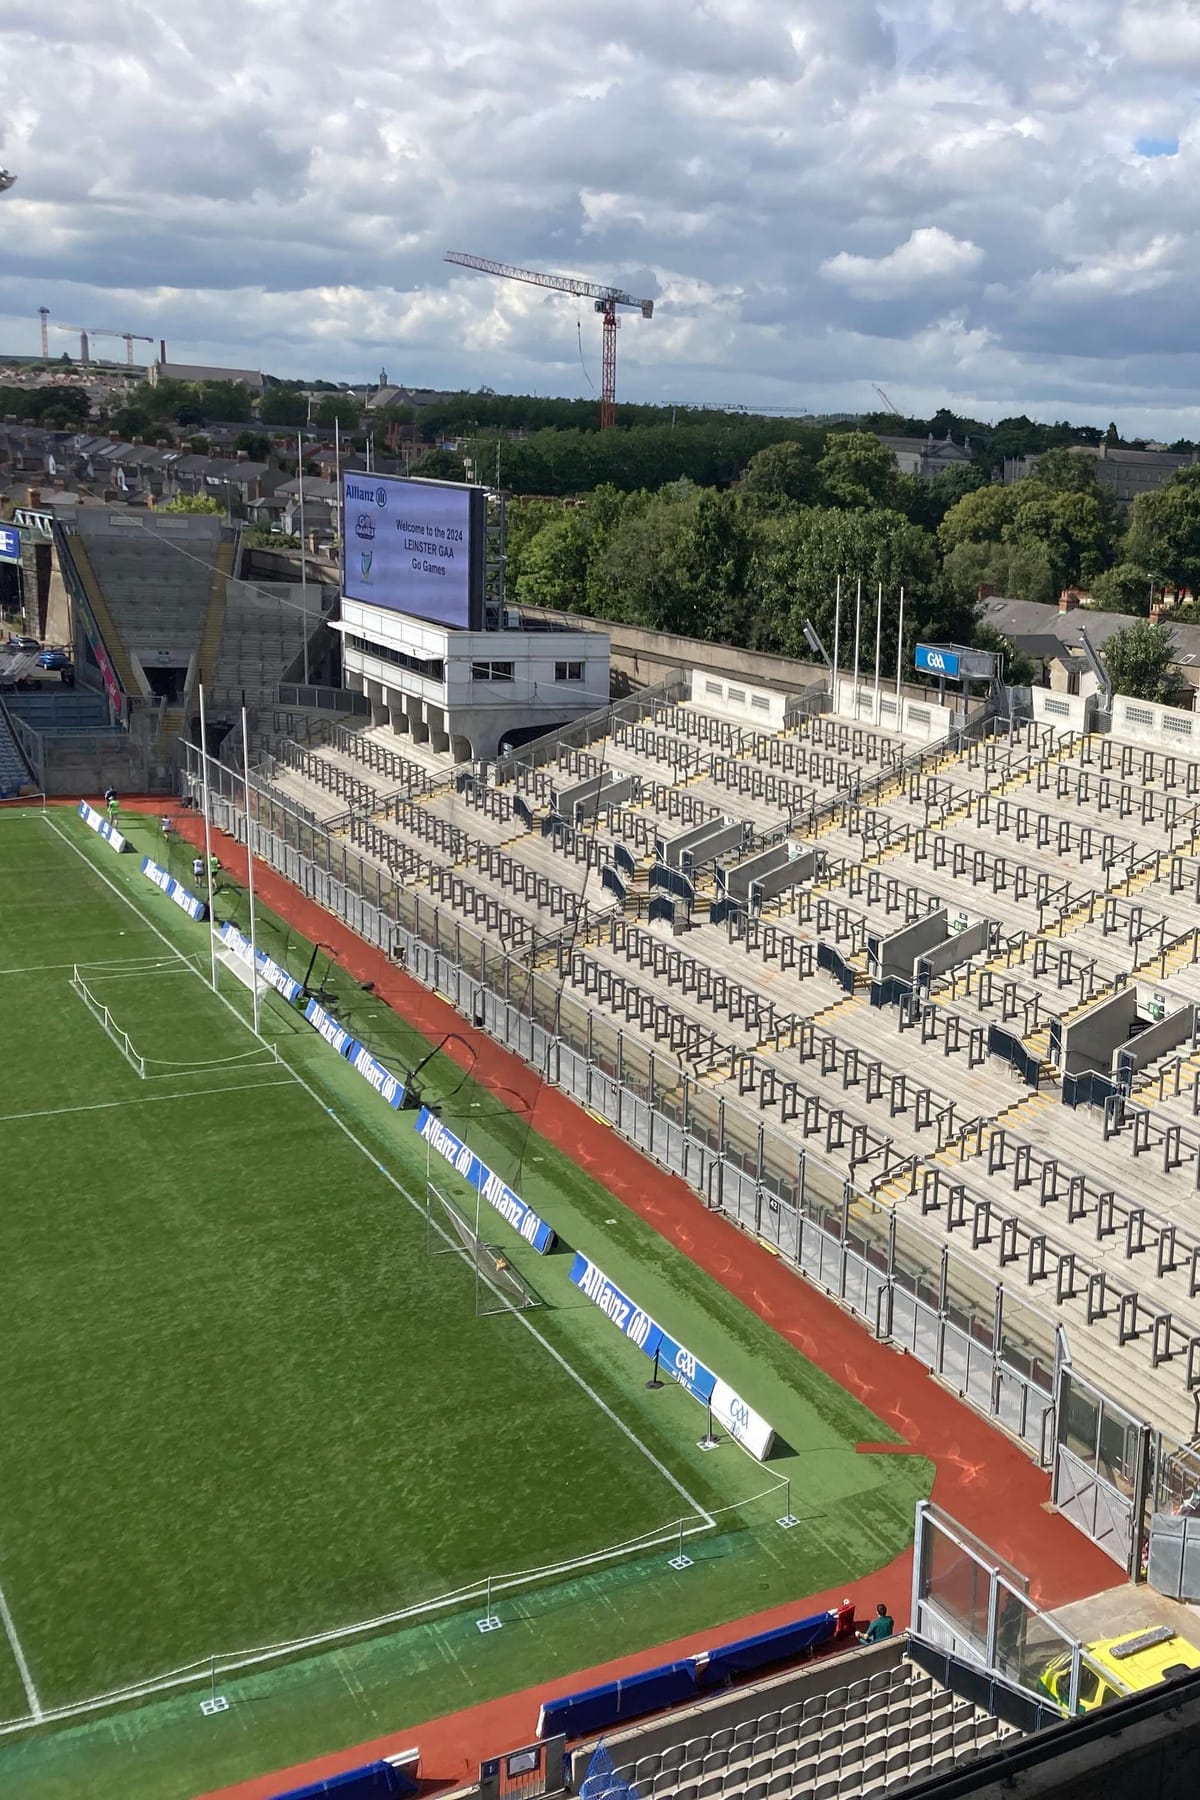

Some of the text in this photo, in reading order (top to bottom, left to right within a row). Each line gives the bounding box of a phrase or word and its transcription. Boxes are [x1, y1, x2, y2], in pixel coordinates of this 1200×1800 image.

[346, 484, 375, 502] Allianz
[396, 519, 463, 541] Welcome to the 2024
[404, 537, 455, 559] LEINSTER GAA
[411, 557, 446, 576] Go Games
[927, 652, 945, 670] GAA
[353, 1047, 385, 1093] Allianz
[420, 1113, 458, 1164] Allianz
[481, 1170, 523, 1230] Allianz
[578, 1262, 630, 1329] Allianz
[674, 1349, 696, 1381] GAA
